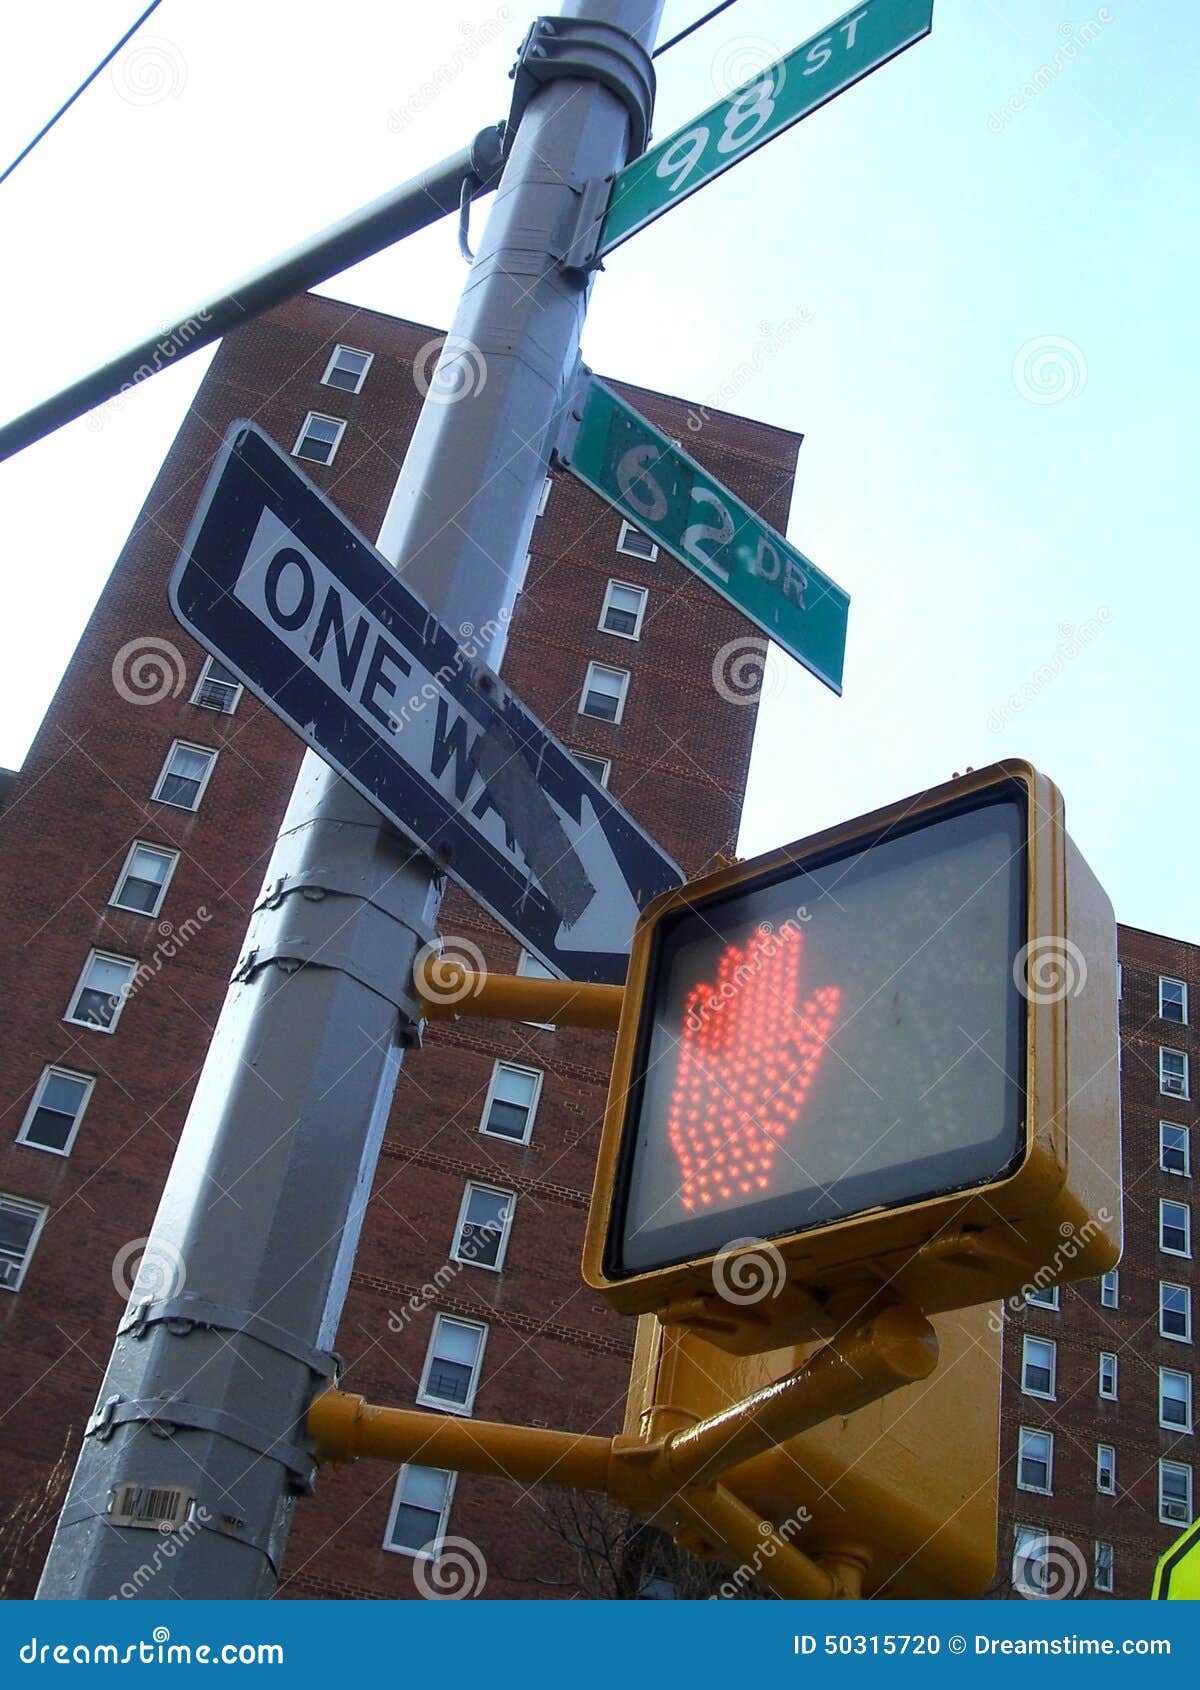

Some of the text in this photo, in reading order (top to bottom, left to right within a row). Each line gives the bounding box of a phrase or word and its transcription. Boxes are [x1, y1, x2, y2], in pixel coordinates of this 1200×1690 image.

[656, 10, 868, 192] 98 ST
[616, 444, 808, 611] 62 DR
[264, 547, 412, 736] ONE
